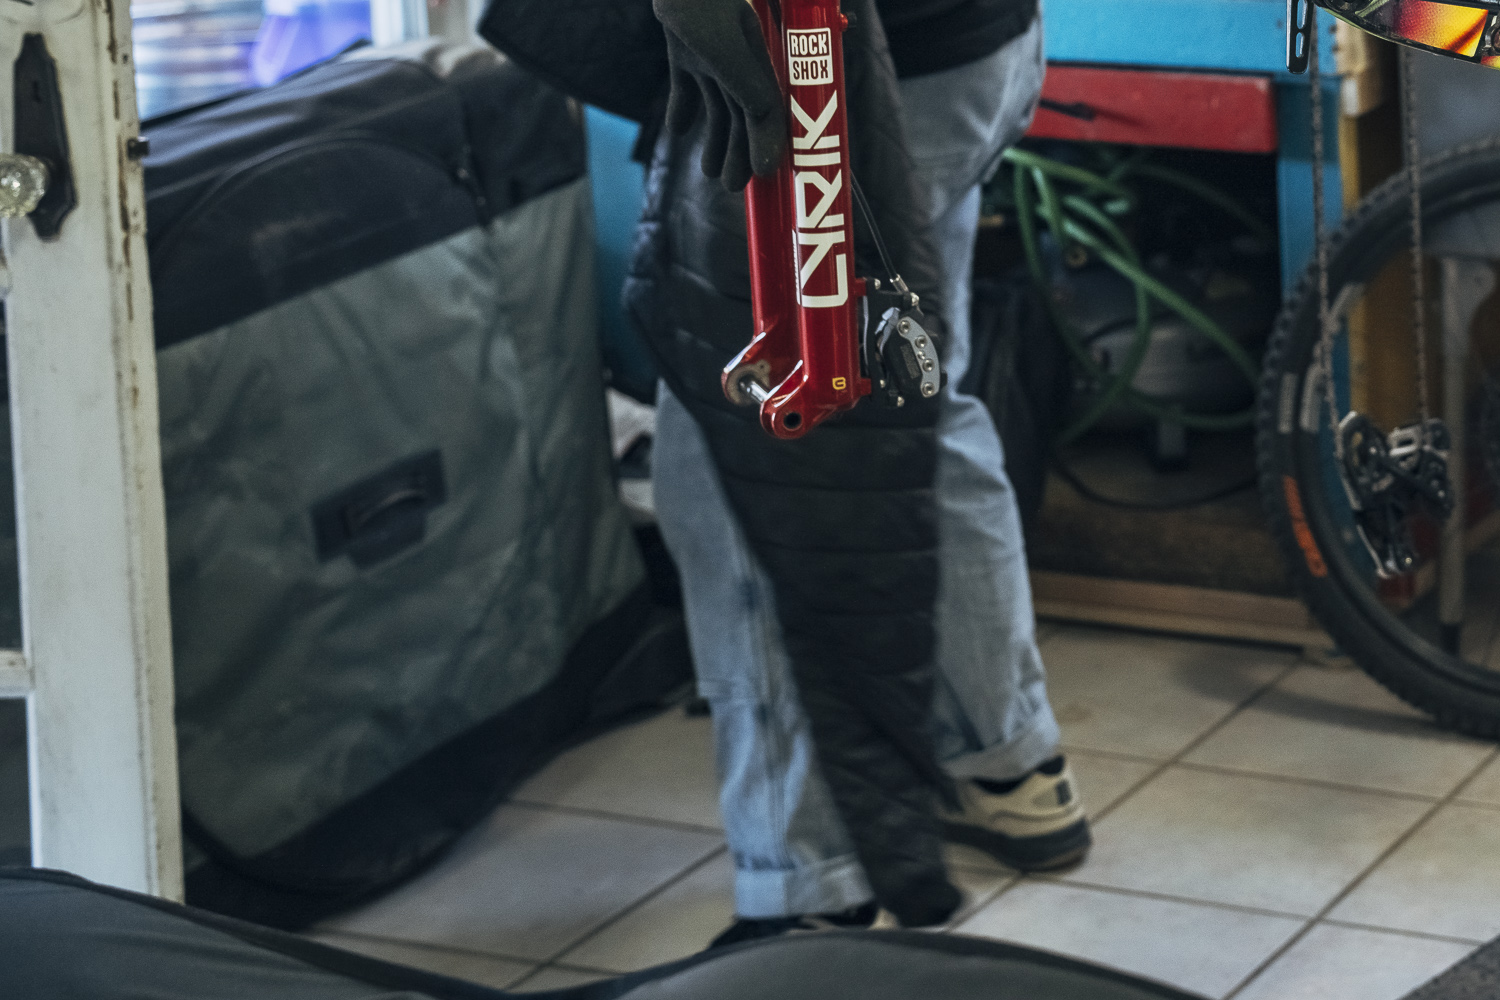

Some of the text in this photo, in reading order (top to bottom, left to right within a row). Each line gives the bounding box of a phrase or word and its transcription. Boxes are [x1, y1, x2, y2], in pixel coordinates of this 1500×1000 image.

[790, 33, 829, 56] ROCK
[792, 58, 830, 81] SHOX
[790, 90, 849, 308] LYRIK
